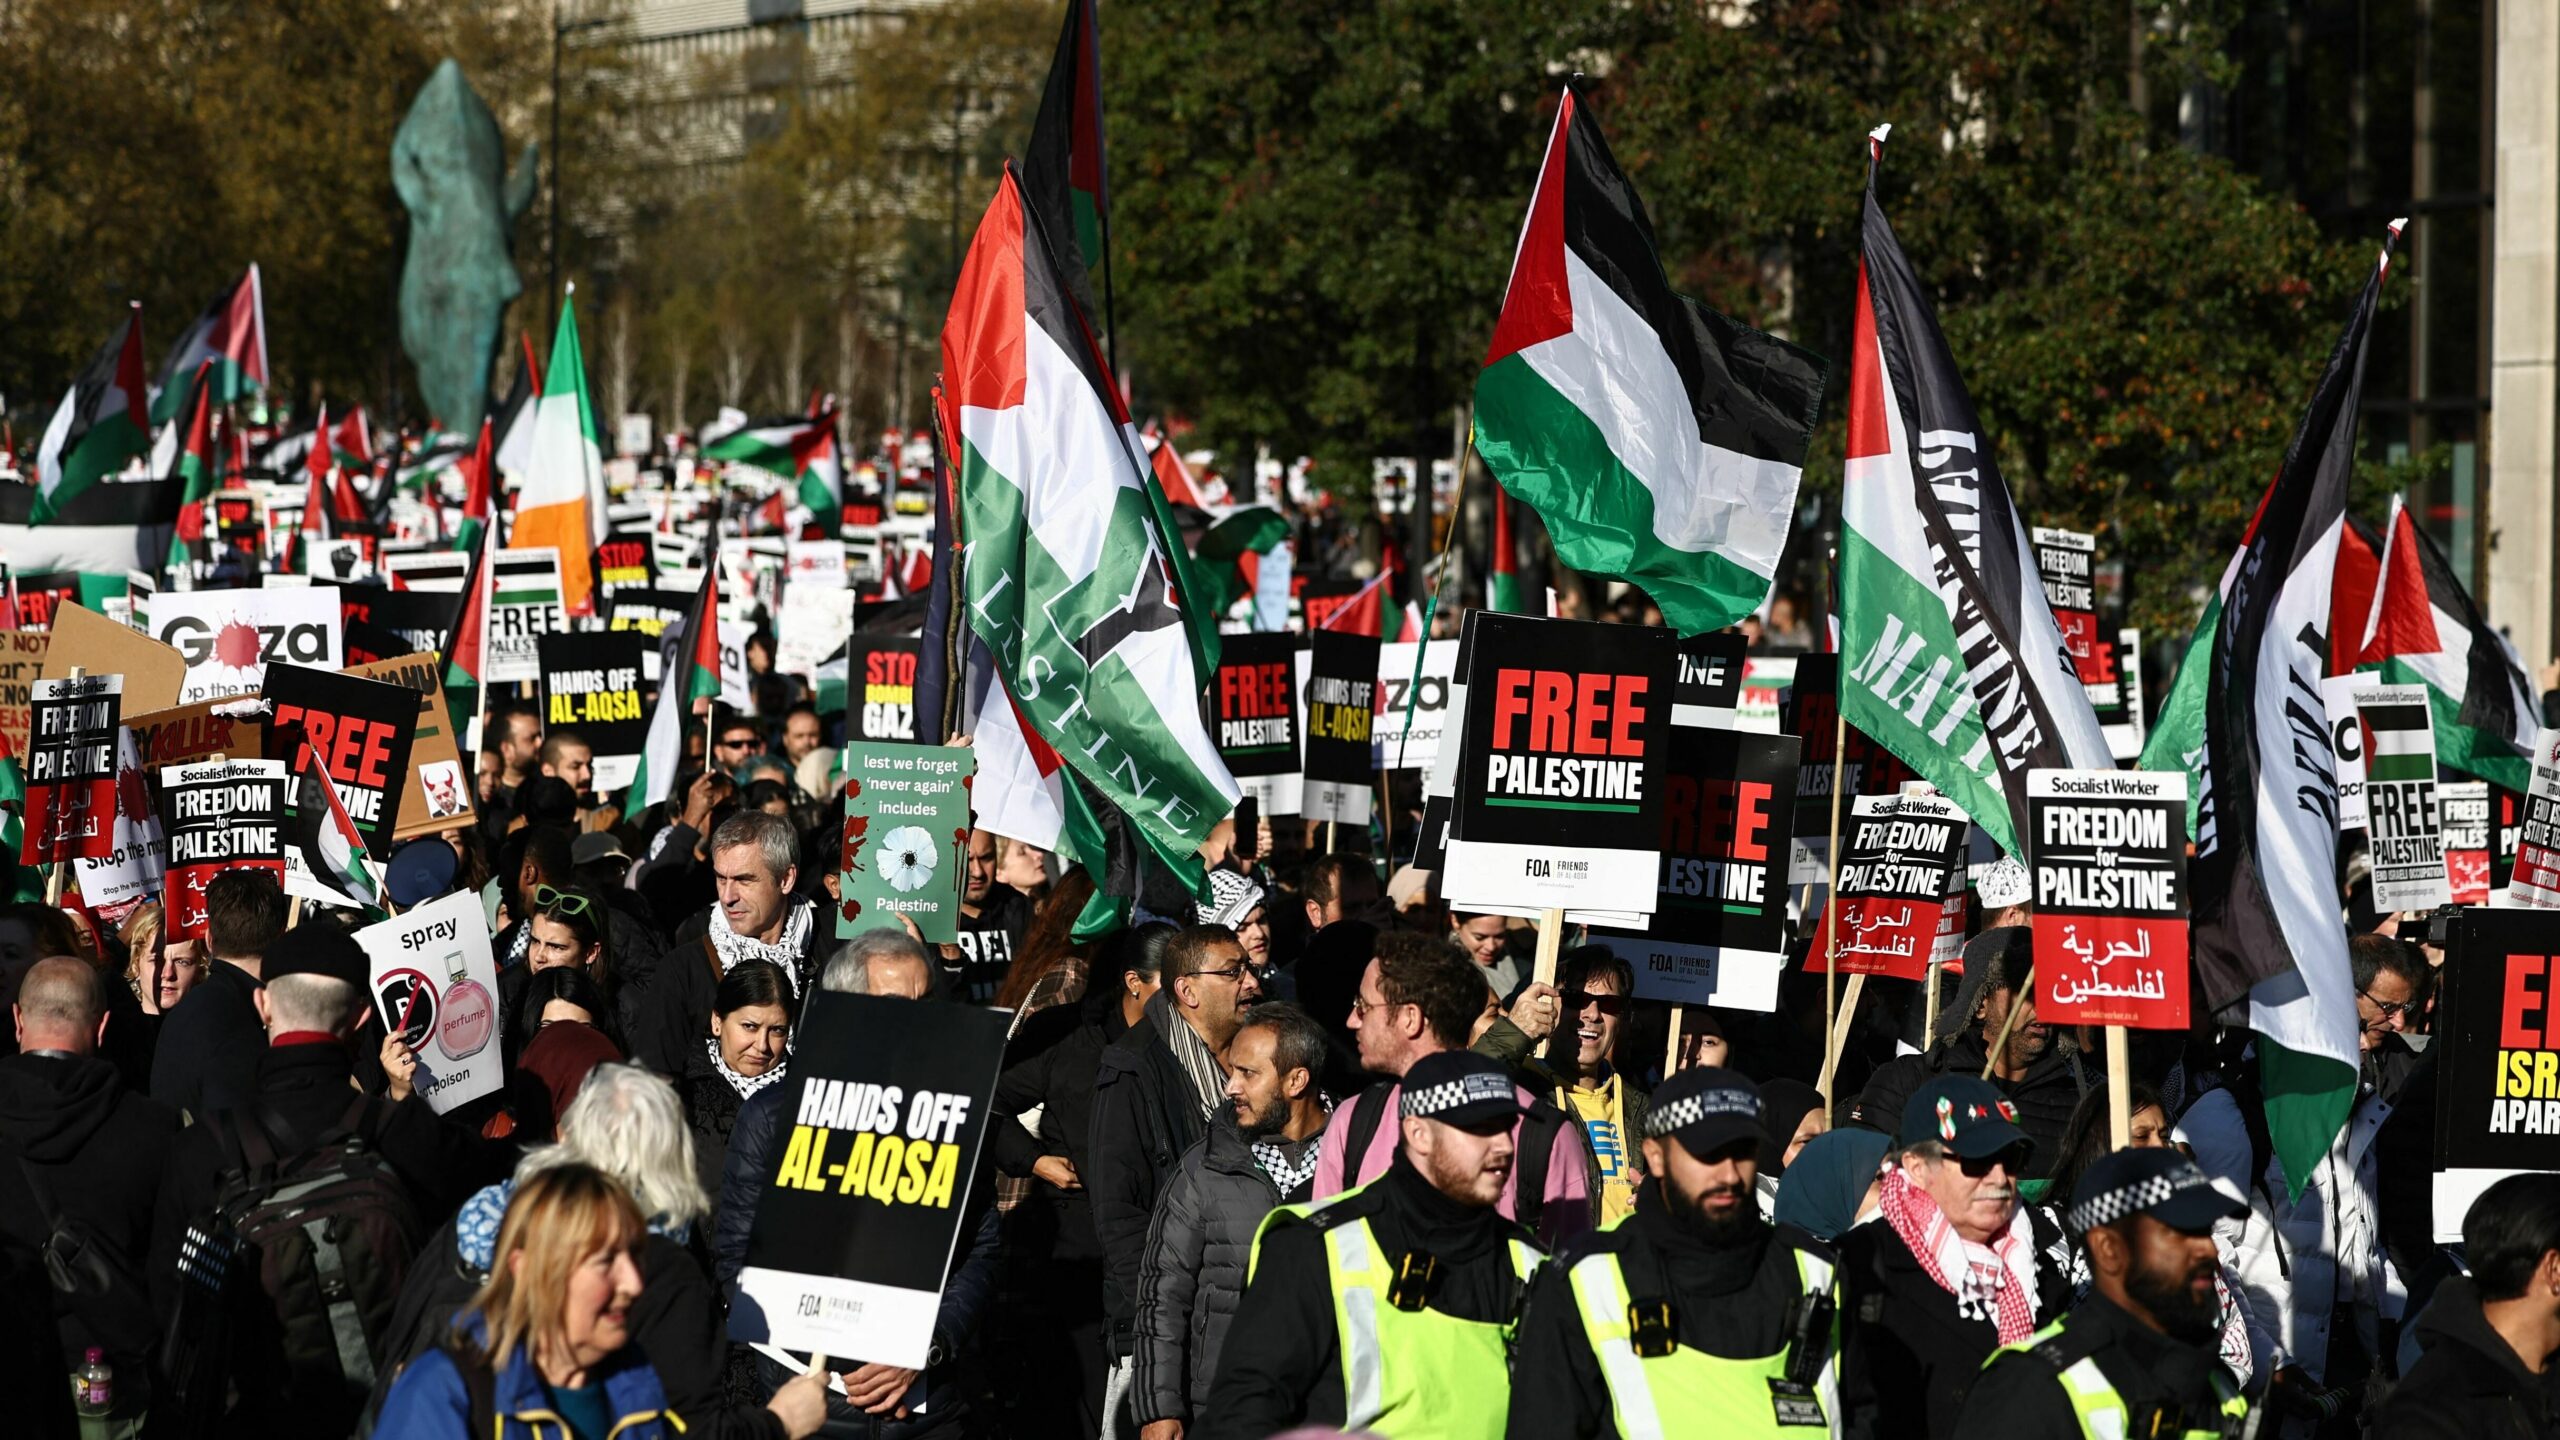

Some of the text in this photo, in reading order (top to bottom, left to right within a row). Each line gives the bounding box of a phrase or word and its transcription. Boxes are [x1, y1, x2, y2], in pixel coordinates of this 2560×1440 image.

[599, 543, 645, 569] STOP
[2040, 548, 2088, 576] FREEDOM
[549, 667, 637, 695] HANDS OFF
[866, 651, 917, 686] STO
[1219, 663, 1289, 719] FREE
[1312, 676, 1371, 707] HANDS OFF
[41, 701, 109, 736] FREEDOM
[549, 690, 642, 724] AL-AQSA
[862, 703, 914, 739] GAZ
[1492, 669, 1648, 757] FREE
[1221, 717, 1291, 747] PALESTINE
[1310, 703, 1370, 742] AL-AQSA
[272, 704, 396, 788] FREE
[33, 745, 111, 779] PALESTINE
[180, 767, 227, 782] Socialist
[226, 765, 266, 777] Worker
[864, 755, 958, 775] lest we forget
[1487, 754, 1644, 800] PALESTINE
[2051, 777, 2159, 796] Socialist Worker
[175, 784, 272, 819] FREEDOM
[878, 801, 938, 816] includes
[1870, 801, 1951, 816] Socialist Worker
[2367, 782, 2438, 838] FREE
[2533, 799, 2550, 821] END
[215, 816, 231, 829] for
[1854, 821, 1951, 853] FREEDOM
[2043, 806, 2167, 849] FREEDOM
[2524, 819, 2549, 846] STATE
[127, 841, 145, 860] the
[172, 826, 278, 863] PALESTINE
[2373, 837, 2442, 865] PALESTINE
[2443, 828, 2489, 849] PALES
[1526, 859, 1550, 877] FOA
[1557, 860, 1589, 872] FRIENDS
[1884, 849, 1903, 864] for
[2095, 847, 2119, 867] for
[1837, 864, 1945, 897] PALESTINE
[2038, 866, 2176, 910] PALESTINE
[876, 897, 938, 912] Palestine
[1843, 904, 1912, 932] الحرية
[401, 917, 457, 951] spray
[1825, 932, 1915, 959] لفلسطين
[2062, 924, 2150, 965] الحرية
[1648, 953, 1673, 973] FOA
[1680, 956, 1711, 969] FRIENDS
[2052, 964, 2165, 1004] لفلسطين
[444, 1008, 486, 1033] perfume
[433, 1068, 470, 1098] poison
[796, 1077, 971, 1144] HANDS OFF
[775, 1124, 960, 1208] AL-AQSA
[797, 1293, 821, 1317] FOA
